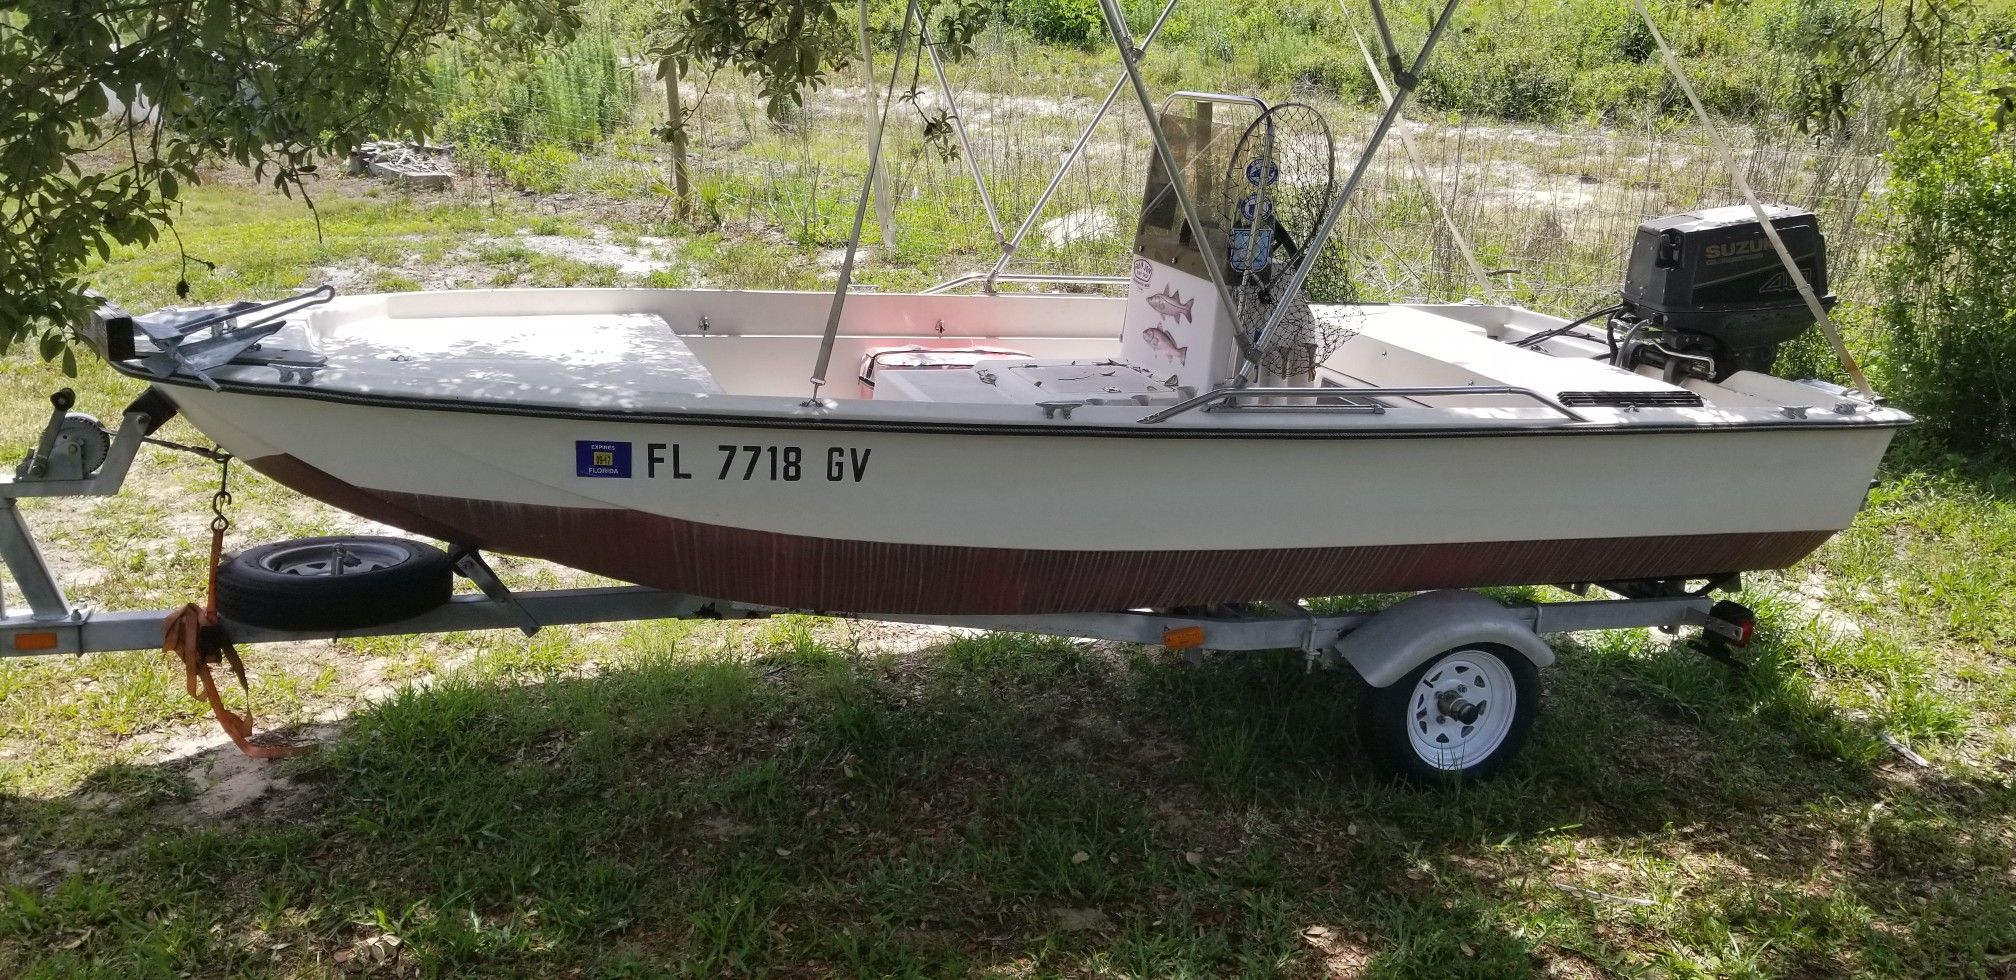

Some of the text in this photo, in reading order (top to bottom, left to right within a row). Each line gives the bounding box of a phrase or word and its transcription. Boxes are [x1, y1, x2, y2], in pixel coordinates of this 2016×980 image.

[647, 443, 872, 482] FL 7718 GV
